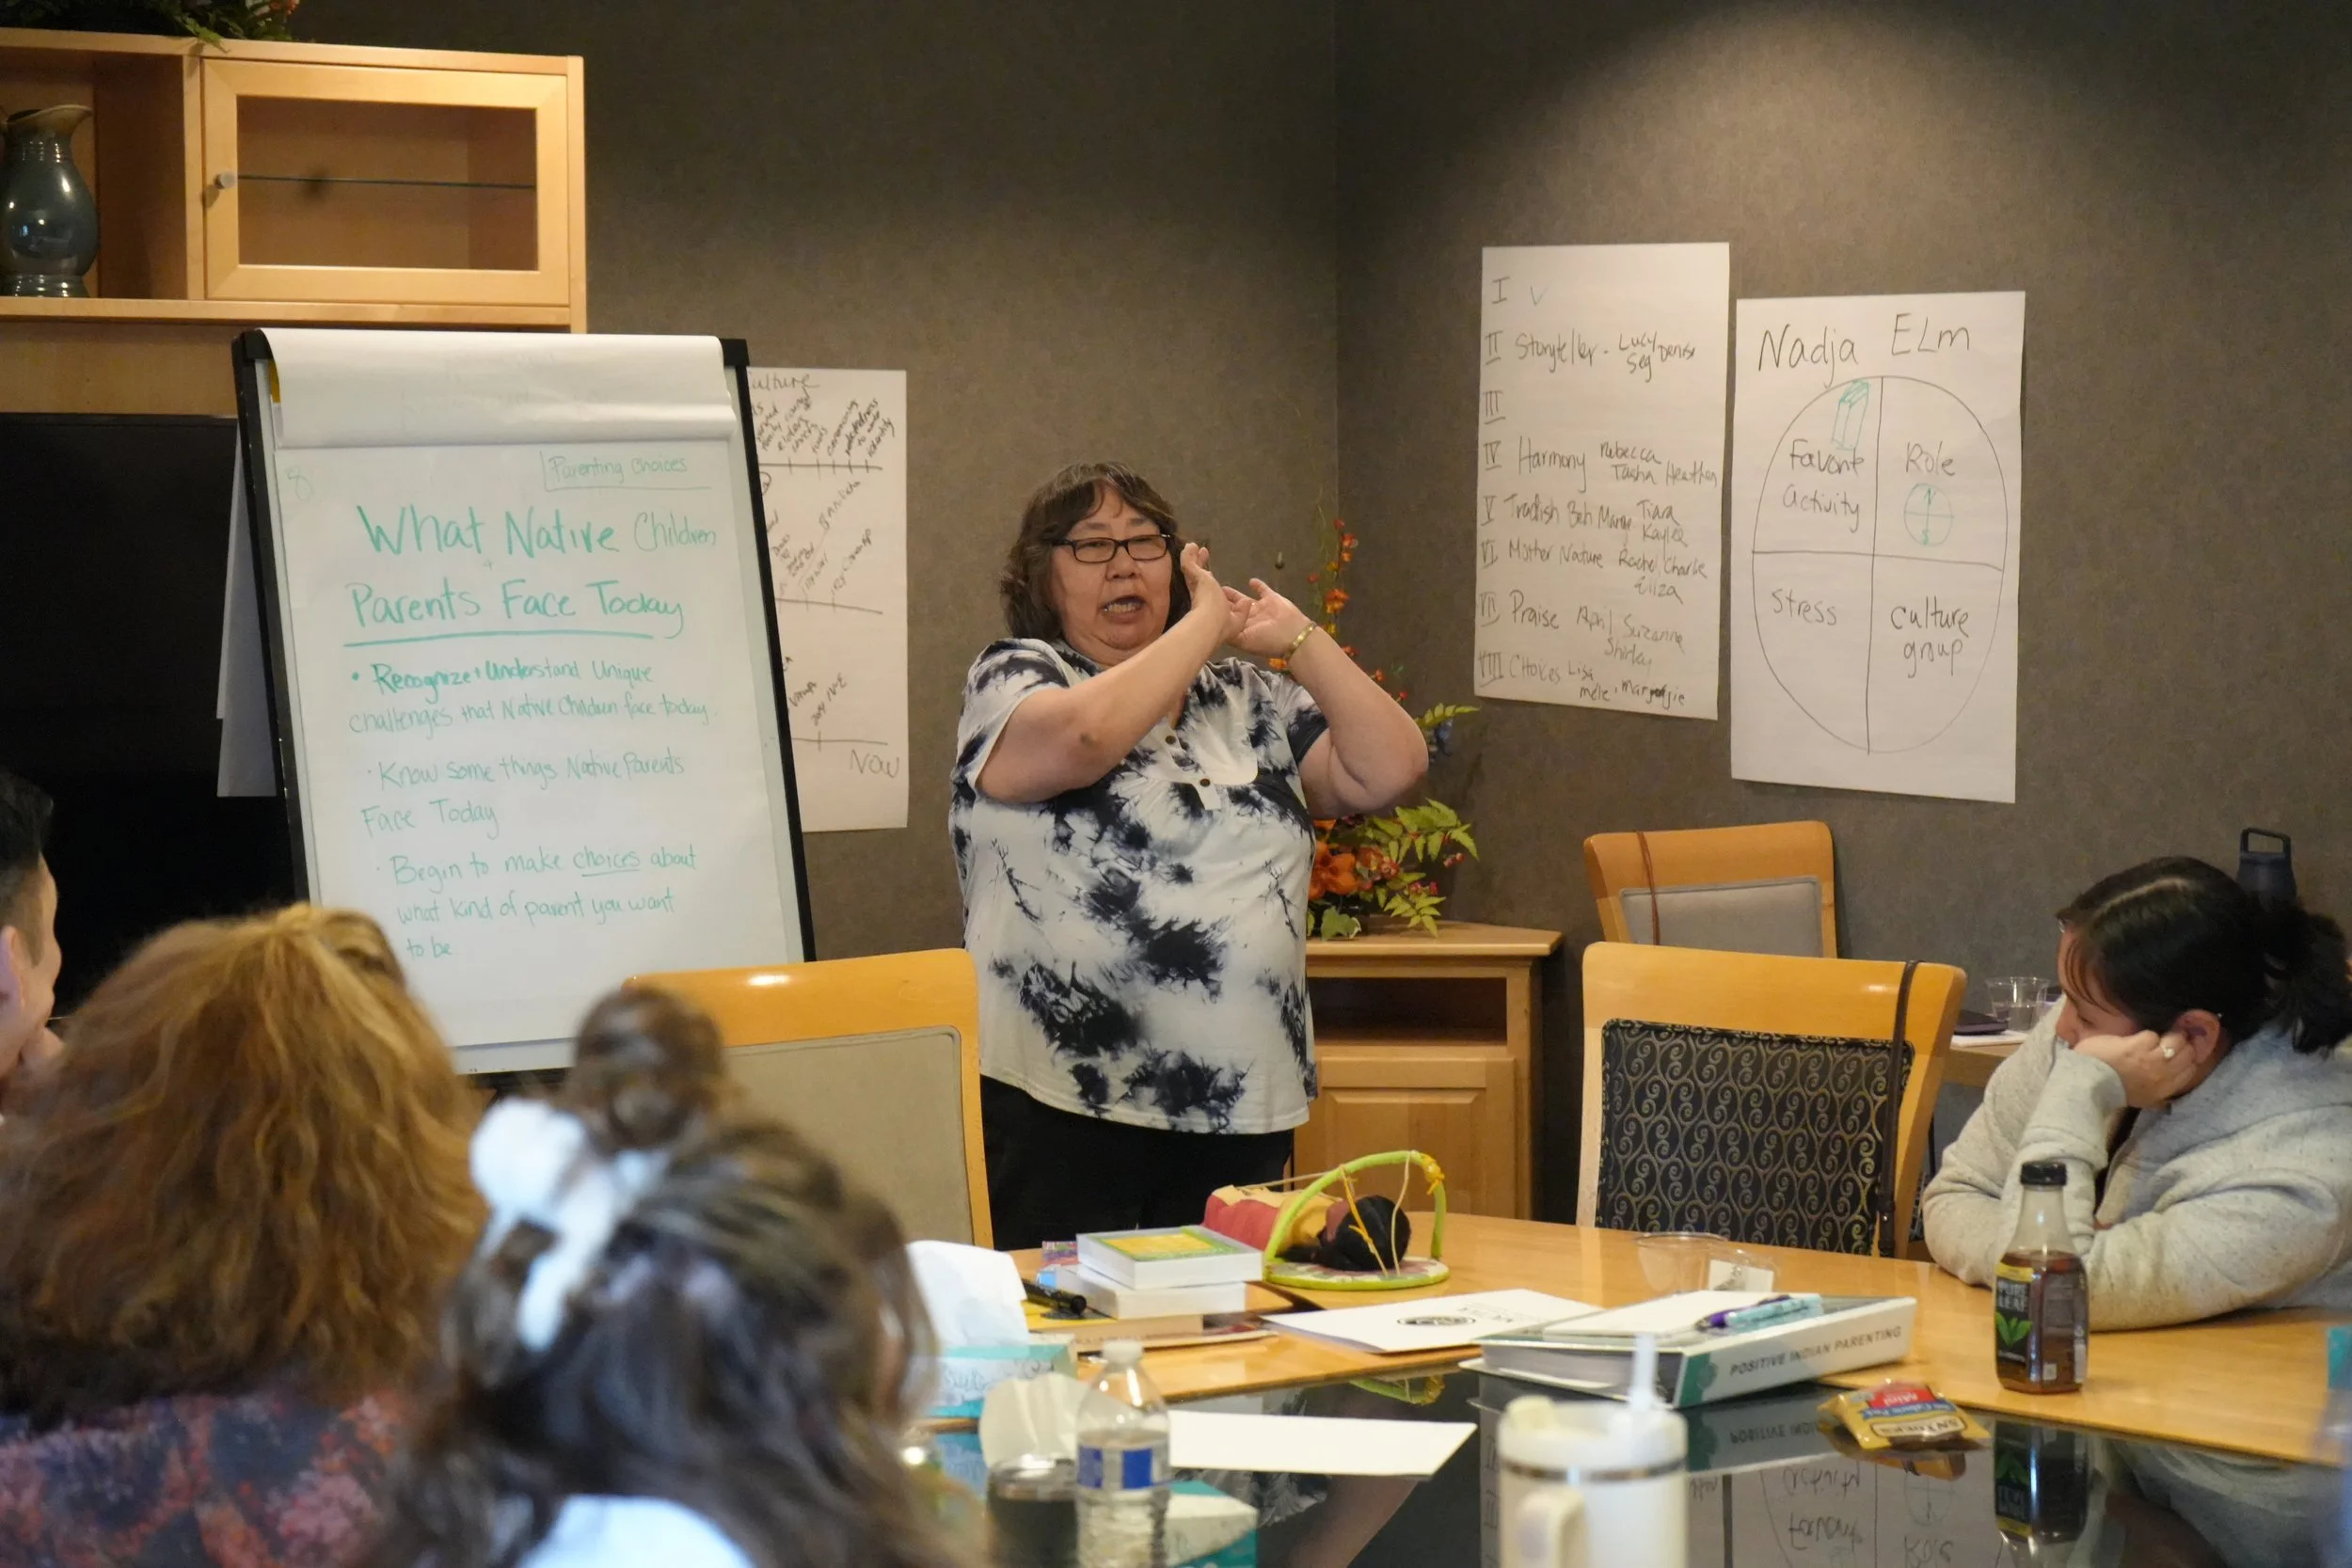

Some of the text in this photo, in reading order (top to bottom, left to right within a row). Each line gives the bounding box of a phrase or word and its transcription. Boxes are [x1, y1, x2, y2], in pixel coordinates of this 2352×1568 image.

[1757, 323, 1859, 389] Nadja
[752, 373, 819, 391] ulture
[548, 455, 625, 484] Parenting
[1518, 436, 1587, 493] Harmony
[1905, 440, 1956, 477] Role
[356, 504, 486, 555] What
[505, 505, 620, 559] Native
[634, 510, 717, 552] Children
[1559, 545, 1604, 569] Nature
[343, 577, 685, 640] Parents Face Today
[1509, 589, 1560, 629] Praise
[1903, 638, 1964, 679] group
[373, 662, 471, 704] Recognize
[485, 658, 580, 685] Understand
[592, 660, 654, 689] Unique
[349, 703, 454, 740] challenges
[461, 699, 494, 722] that
[501, 693, 553, 721] Native
[558, 693, 618, 717] Children
[625, 690, 656, 720] face
[379, 758, 438, 791] Know
[499, 755, 557, 790] things
[566, 750, 619, 780] Native
[622, 747, 685, 780] Parents
[361, 798, 499, 840] Face Today
[389, 844, 696, 894] Begin to make choices about
[397, 887, 674, 930] what kind of parent you want
[406, 935, 453, 958] to be
[1730, 1325, 1902, 1376] POSITIVE INDIAN PARENTING
